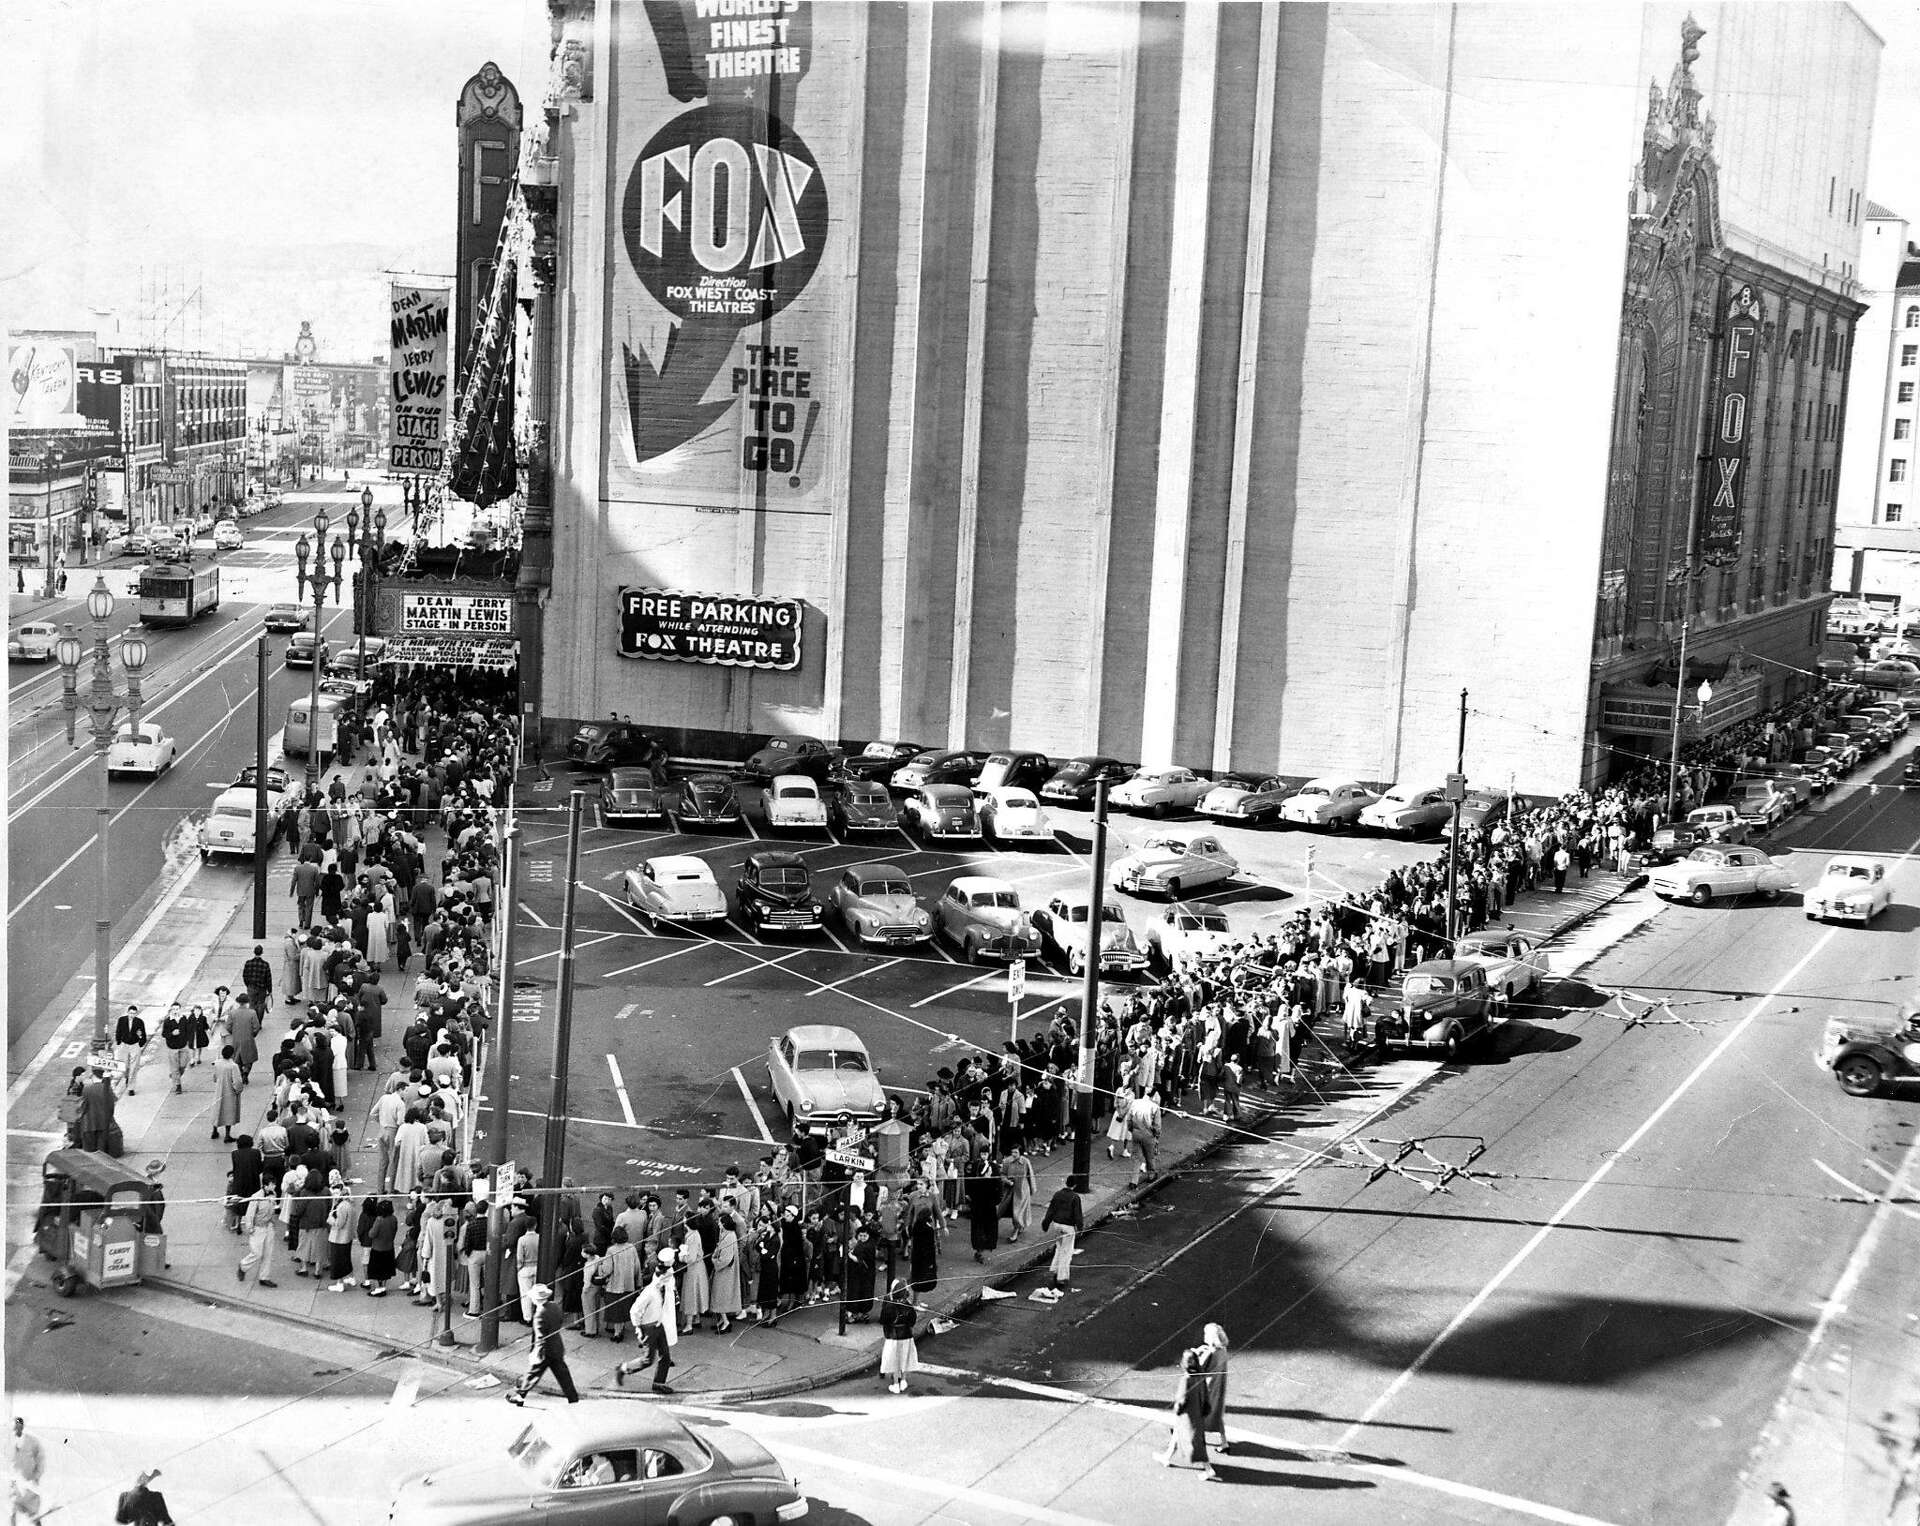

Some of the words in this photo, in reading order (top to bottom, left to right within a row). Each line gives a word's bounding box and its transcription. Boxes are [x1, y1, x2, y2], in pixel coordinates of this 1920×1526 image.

[695, 0, 800, 18] WORLDS
[710, 19, 790, 48] FINEST
[705, 47, 800, 79] THEATRE
[640, 137, 814, 273] FOX
[699, 275, 746, 288] Direction
[392, 290, 422, 314] DEAN
[667, 286, 692, 300] FOX
[695, 287, 731, 300] WEST
[735, 288, 778, 301] COAST
[689, 300, 756, 314] THEATRES
[391, 303, 449, 349] MARTIN
[403, 350, 434, 367] JERRY
[746, 344, 799, 367] THE
[393, 369, 447, 403] LEWIS
[732, 367, 811, 398] PLACE
[395, 405, 413, 414] ON
[416, 406, 442, 415] OUR
[749, 398, 795, 434] TO
[1713, 327, 1755, 508] FOX
[398, 415, 438, 439] STAGE
[410, 438, 426, 446] IN
[392, 446, 442, 470] PERSON
[417, 597, 453, 606] DEAN
[470, 599, 505, 608] JERRY
[406, 607, 461, 619] MARTIN
[467, 608, 508, 621] LEWIS
[629, 597, 681, 618] FREE
[690, 600, 791, 627] PARKING
[406, 619, 440, 629] STAGE
[449, 620, 459, 629] IN
[463, 620, 506, 631] PERSON
[658, 620, 691, 631] WHILE
[697, 623, 759, 636] ATTENDING
[635, 632, 677, 650] FOX
[686, 635, 782, 659] THEATRE
[840, 1131, 864, 1147] HAYES
[626, 1159, 702, 1174] PARKING
[834, 1153, 866, 1167] LARKIN
[640, 1169, 664, 1177] NO
